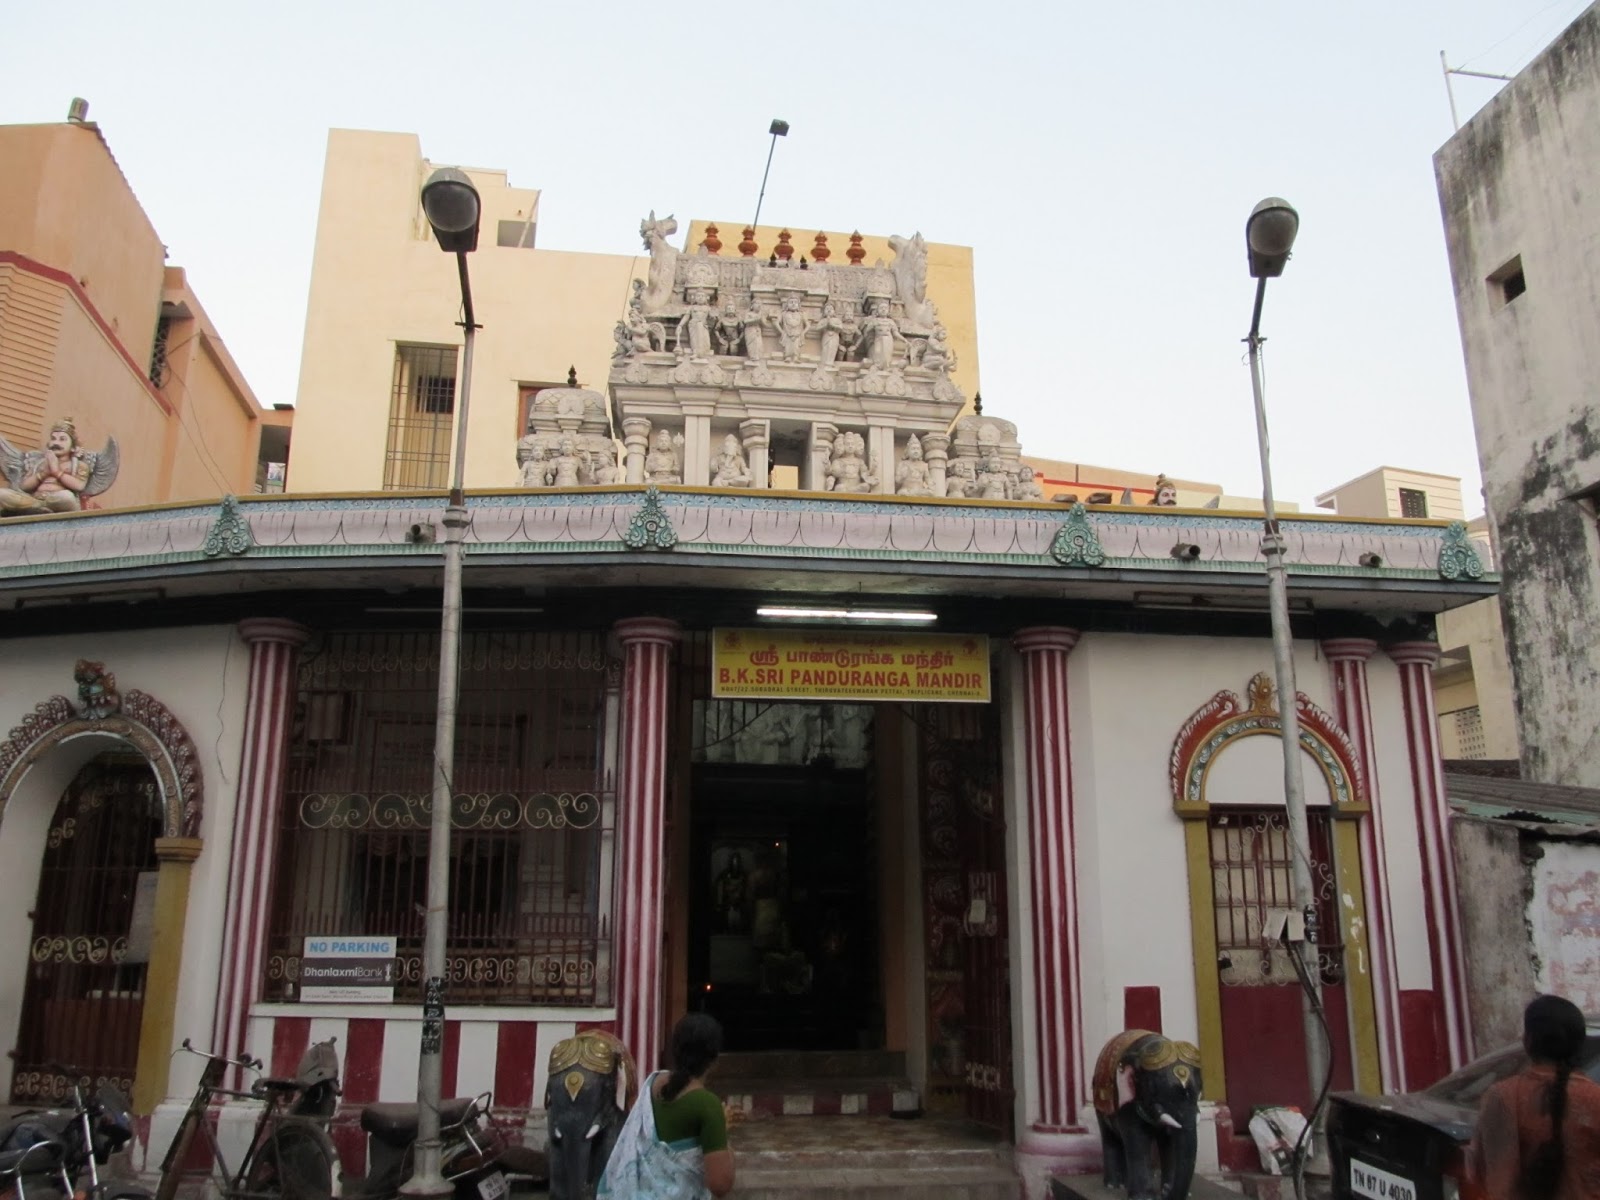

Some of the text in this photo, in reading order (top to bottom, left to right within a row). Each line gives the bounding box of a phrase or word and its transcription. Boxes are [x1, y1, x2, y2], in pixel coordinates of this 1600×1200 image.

[902, 649, 954, 669] மந்திர்
[719, 668, 982, 688] B.K.SRI PANDURANGA MANDIR
[309, 942, 390, 953] NO PARKING
[1353, 1168, 1364, 1187] TN
[1379, 1179, 1386, 1196] U
